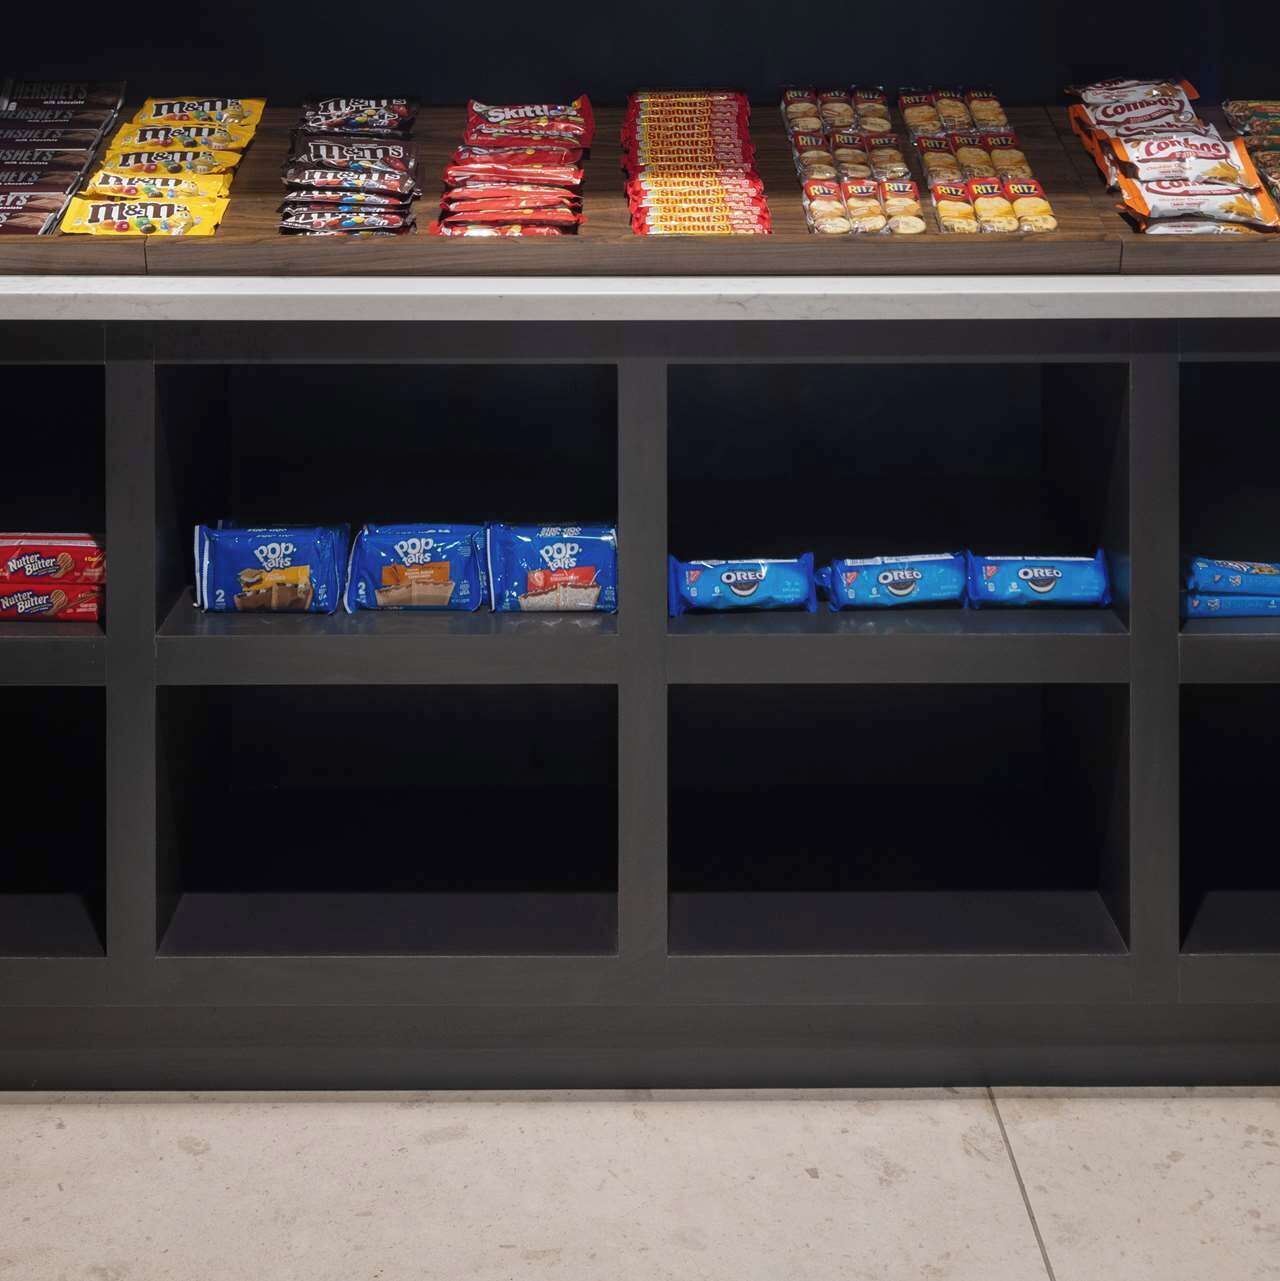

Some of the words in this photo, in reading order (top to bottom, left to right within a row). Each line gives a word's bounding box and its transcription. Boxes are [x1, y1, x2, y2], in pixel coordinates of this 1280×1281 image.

[848, 184, 876, 194] RITZ
[886, 182, 912, 192] RITZ
[938, 186, 965, 196] RITZ
[972, 184, 1000, 193] RITZ
[1009, 184, 1037, 194] RITZ
[7, 553, 40, 572] Nutter
[25, 558, 56, 576] Butter
[720, 569, 766, 584] OREO
[878, 569, 923, 583] OREO
[1018, 567, 1062, 580] OREO
[358, 582, 366, 594] 2
[0, 590, 33, 609] Nutter
[215, 590, 224, 602] 2
[17, 595, 49, 613] Butter
